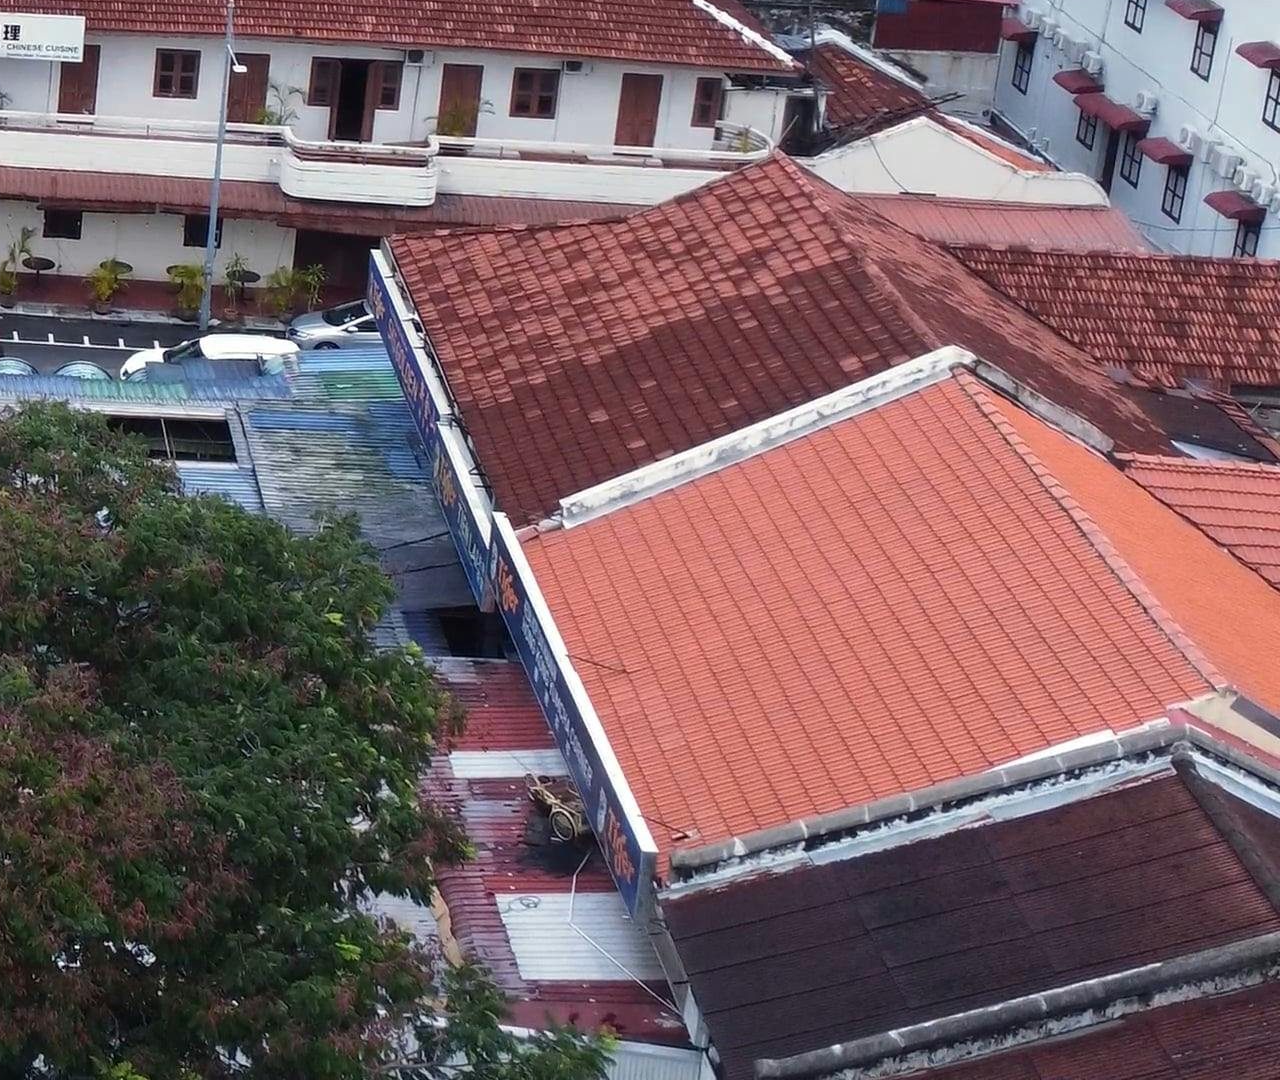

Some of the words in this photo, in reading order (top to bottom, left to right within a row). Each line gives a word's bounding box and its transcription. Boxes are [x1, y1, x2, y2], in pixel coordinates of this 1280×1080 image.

[6, 43, 44, 52] CHINESE
[45, 44, 79, 54] CUISINE
[499, 555, 518, 615] Tiger
[608, 806, 635, 884] Tiger
